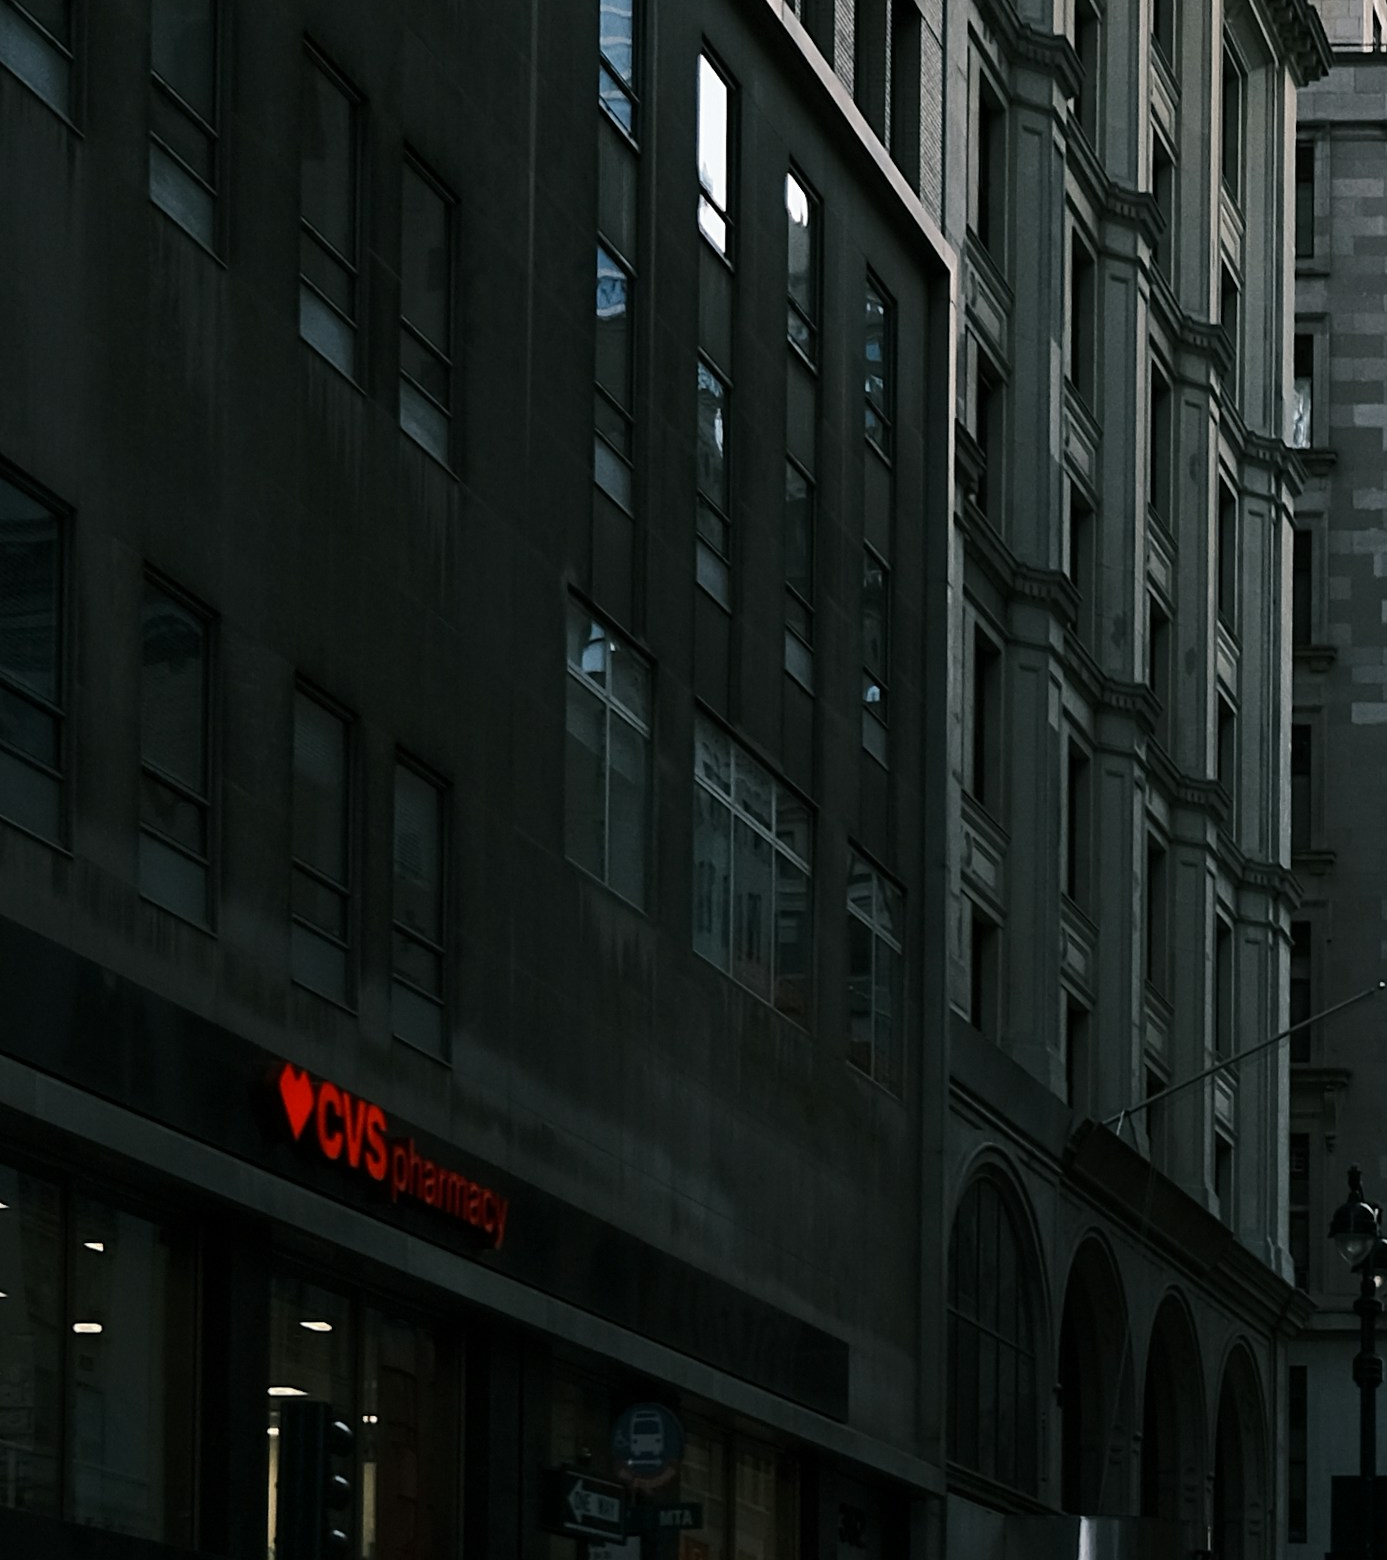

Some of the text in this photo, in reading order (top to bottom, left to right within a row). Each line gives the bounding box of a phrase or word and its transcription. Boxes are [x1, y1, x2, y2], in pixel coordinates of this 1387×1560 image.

[316, 1080, 509, 1250] CVS pharmacy
[658, 1509, 693, 1526] MTA
